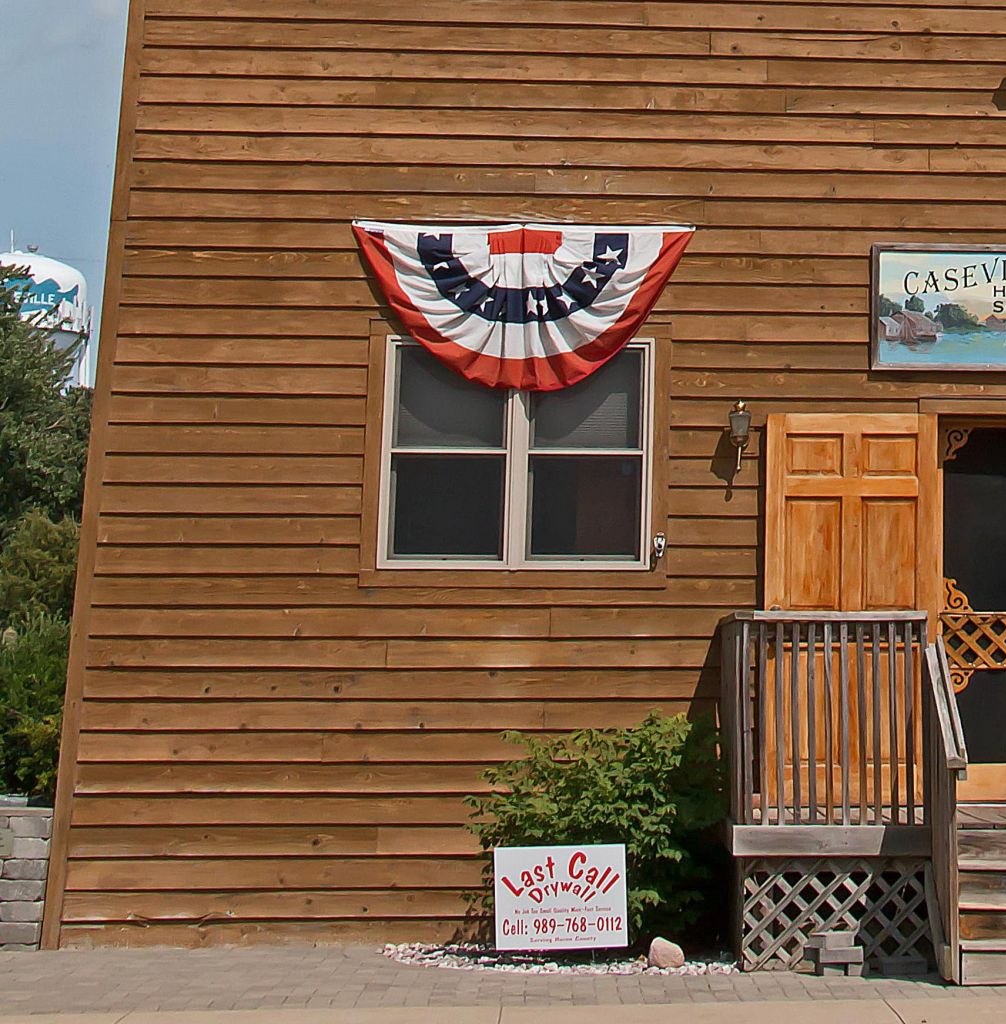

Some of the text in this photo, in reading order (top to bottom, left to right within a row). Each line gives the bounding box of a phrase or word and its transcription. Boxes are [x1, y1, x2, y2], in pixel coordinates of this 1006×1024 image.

[501, 851, 620, 897] Last Call
[528, 881, 596, 904] Drywall
[502, 916, 623, 936] Cell: 989-768-0112
